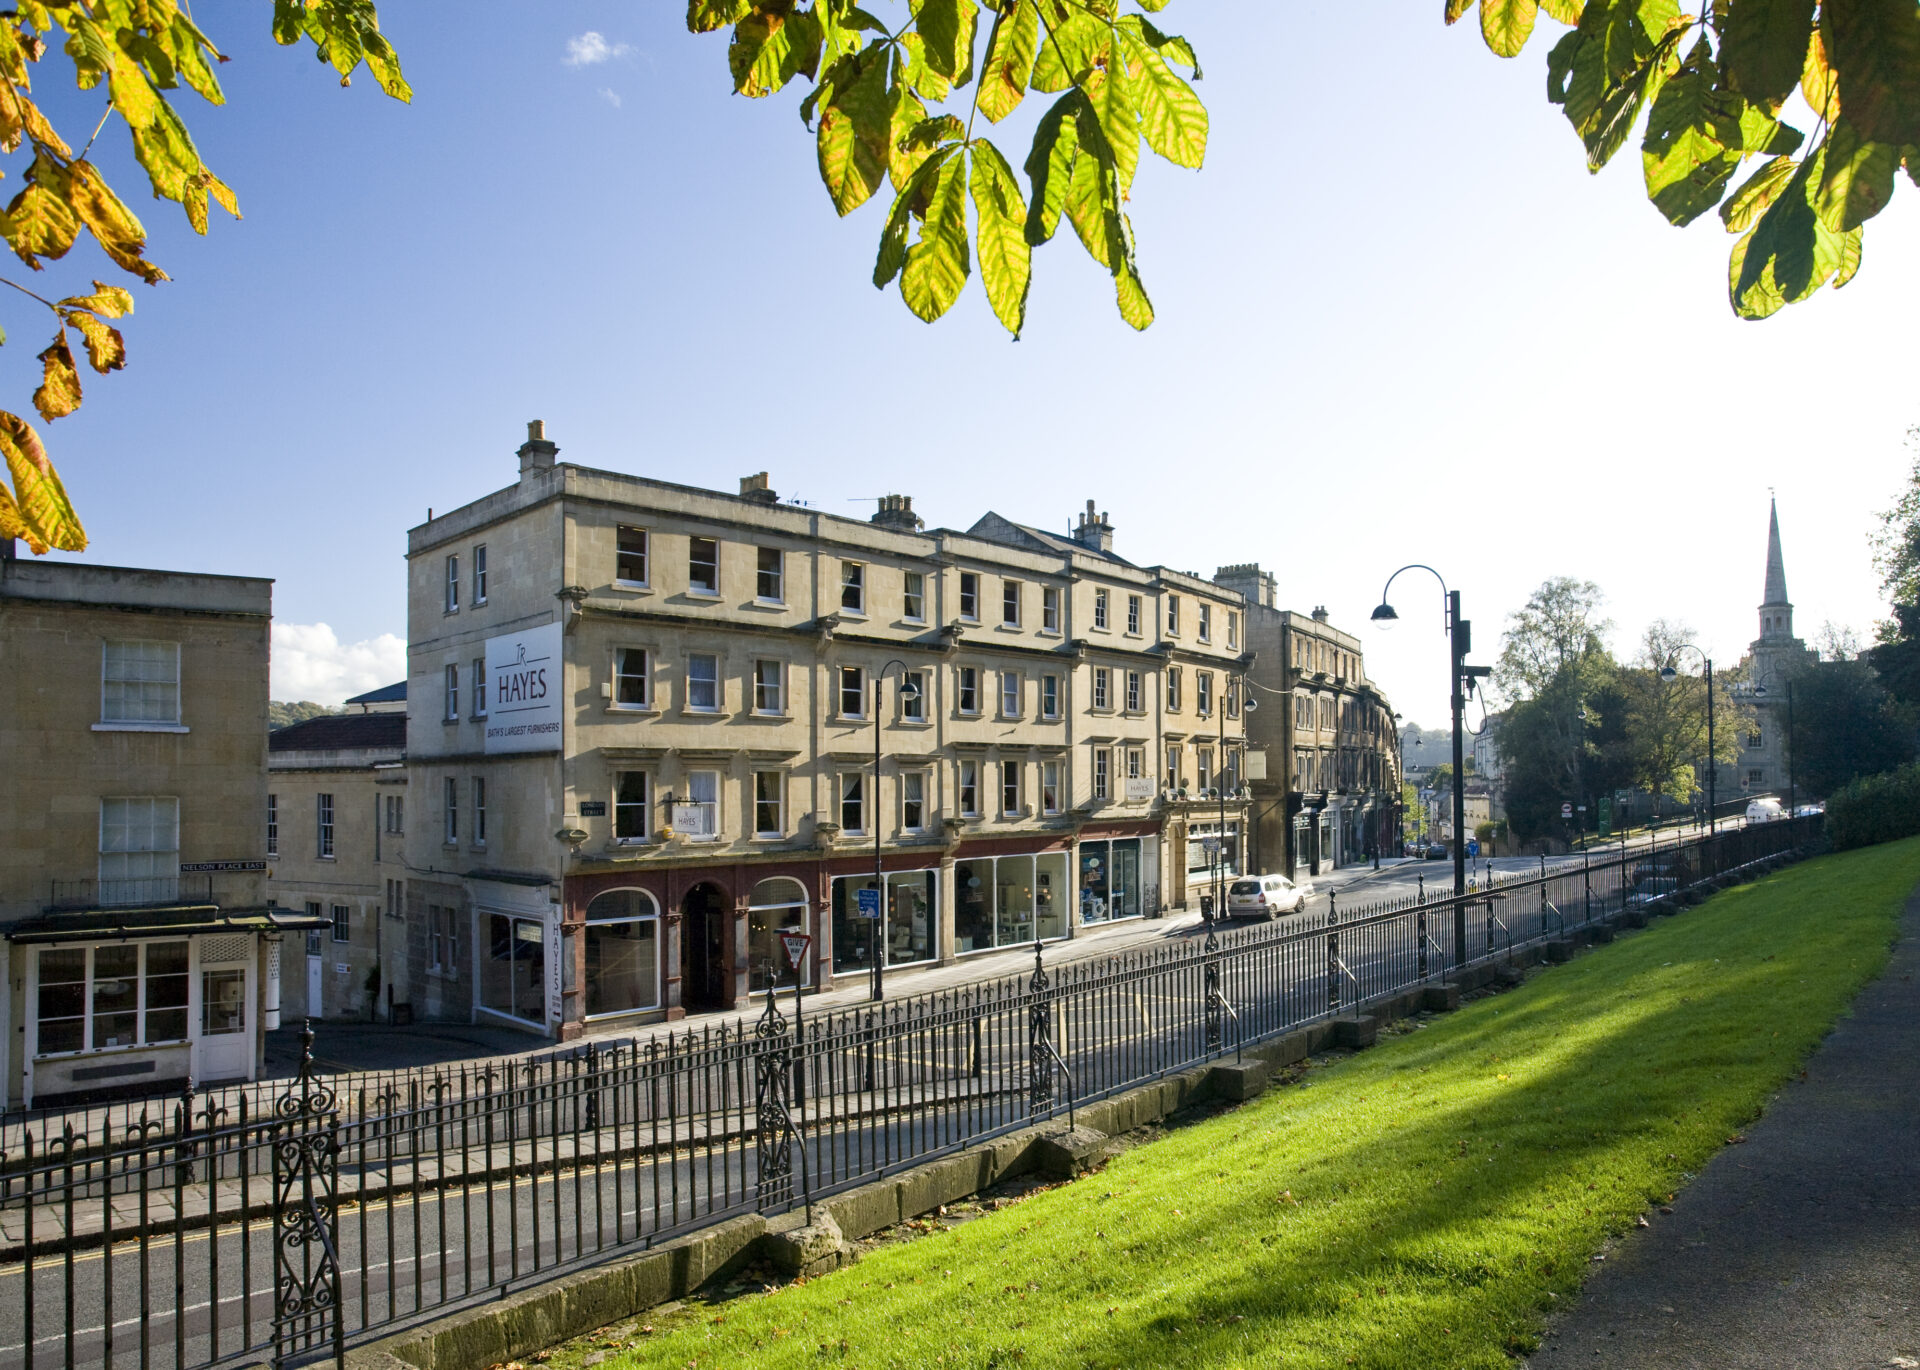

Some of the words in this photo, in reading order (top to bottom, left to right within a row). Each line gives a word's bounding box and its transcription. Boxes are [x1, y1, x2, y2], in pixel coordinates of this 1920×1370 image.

[498, 668, 547, 704] HAYES
[488, 728, 504, 738] BATH'S
[504, 725, 527, 736] LARGEST
[527, 722, 560, 735] FURNISHERS
[678, 817, 696, 826] HAYES
[182, 863, 215, 871] NELSON
[787, 938, 804, 947] GIVE
